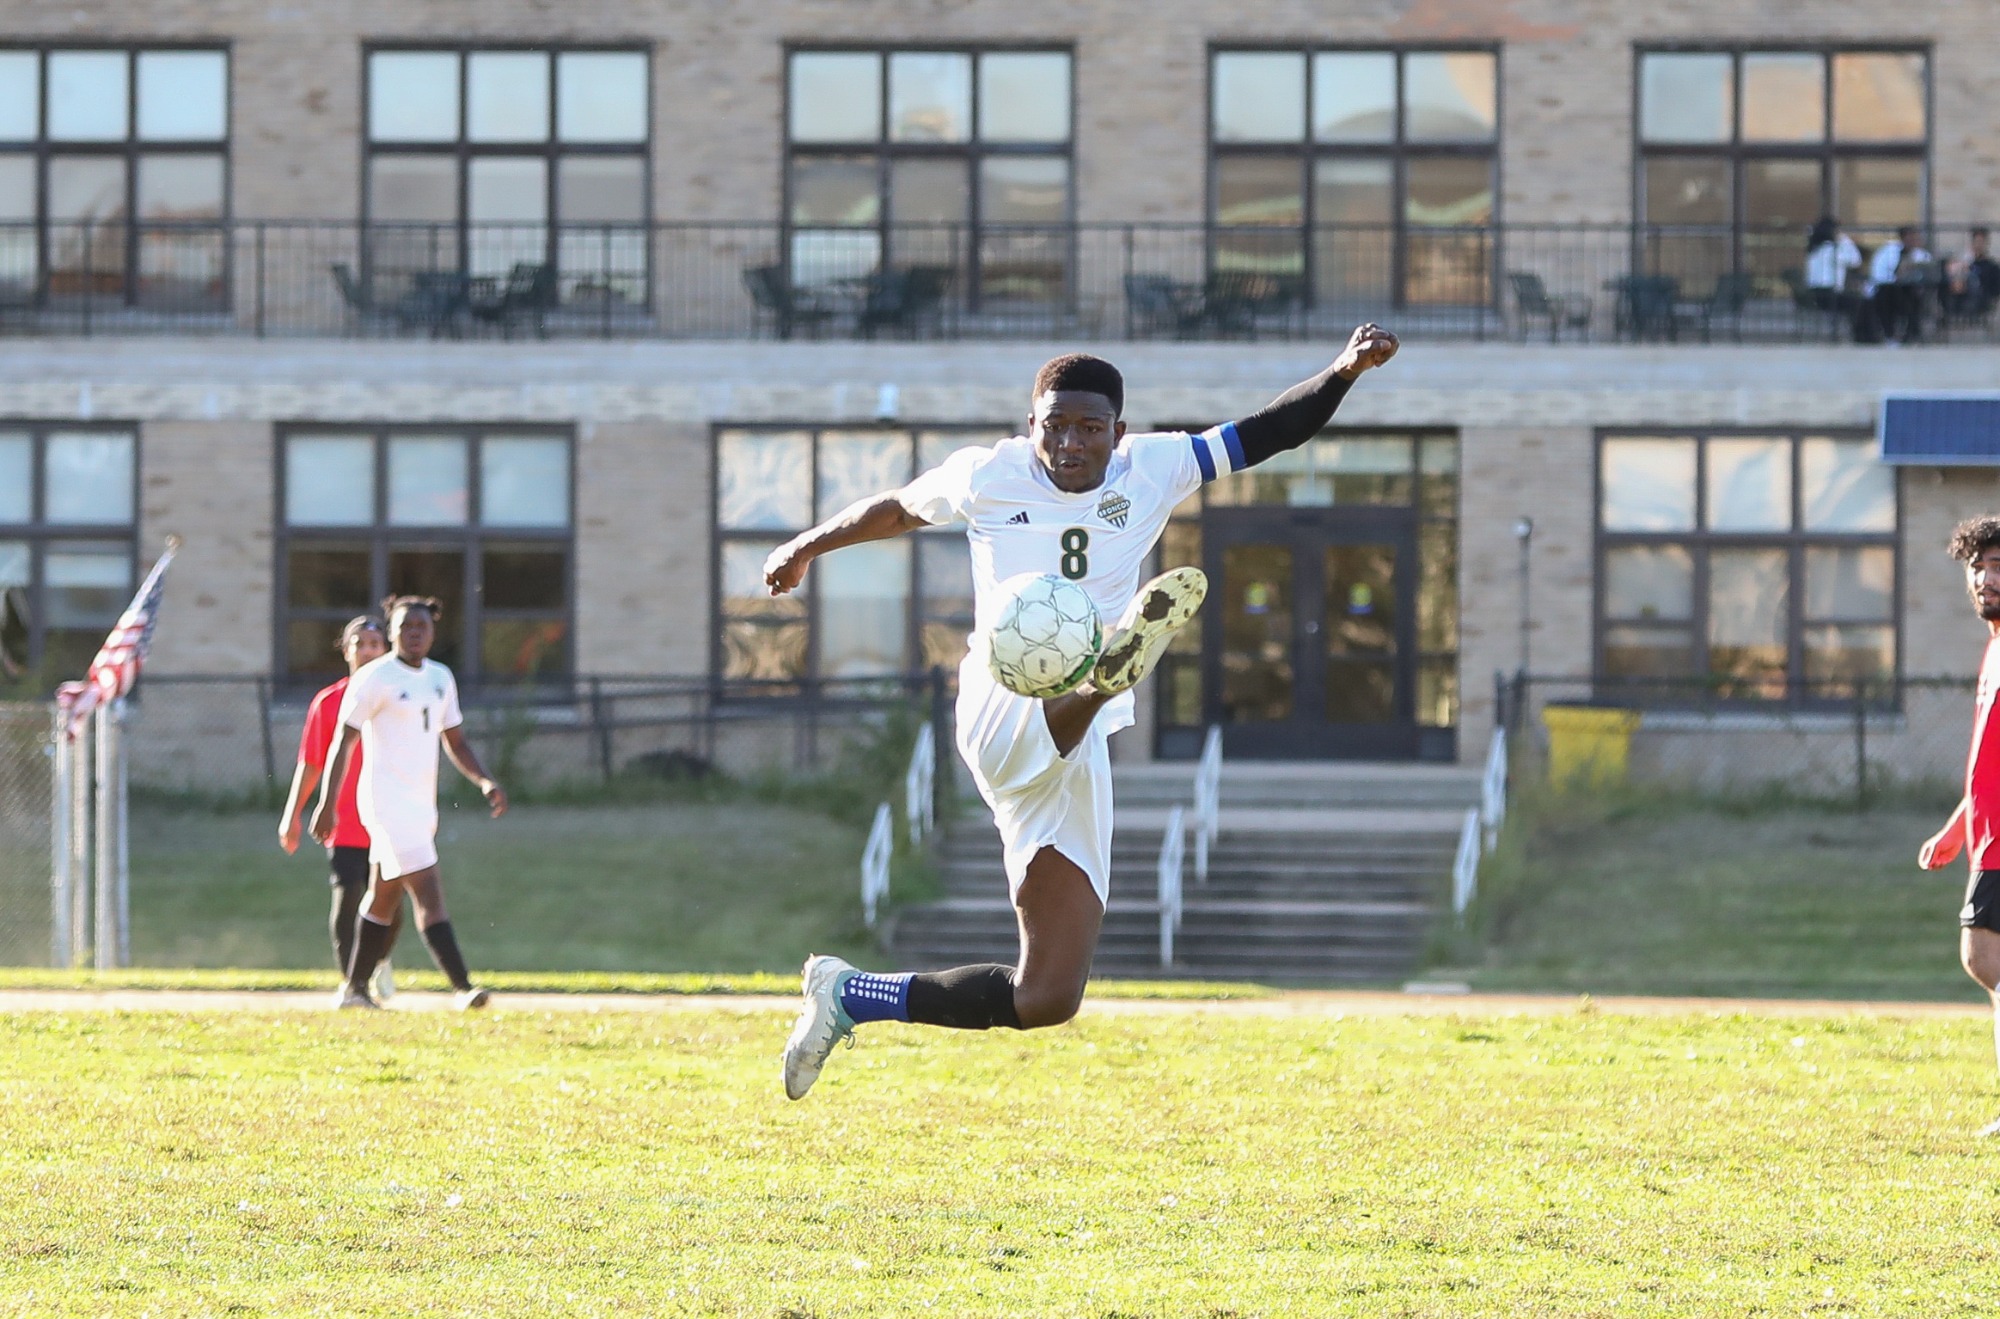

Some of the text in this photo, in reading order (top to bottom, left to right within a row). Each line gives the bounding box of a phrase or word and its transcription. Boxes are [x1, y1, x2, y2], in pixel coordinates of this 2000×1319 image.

[1098, 501, 1130, 518] BRONCOS
[1061, 528, 1089, 580] 8
[422, 706, 429, 732] 1
